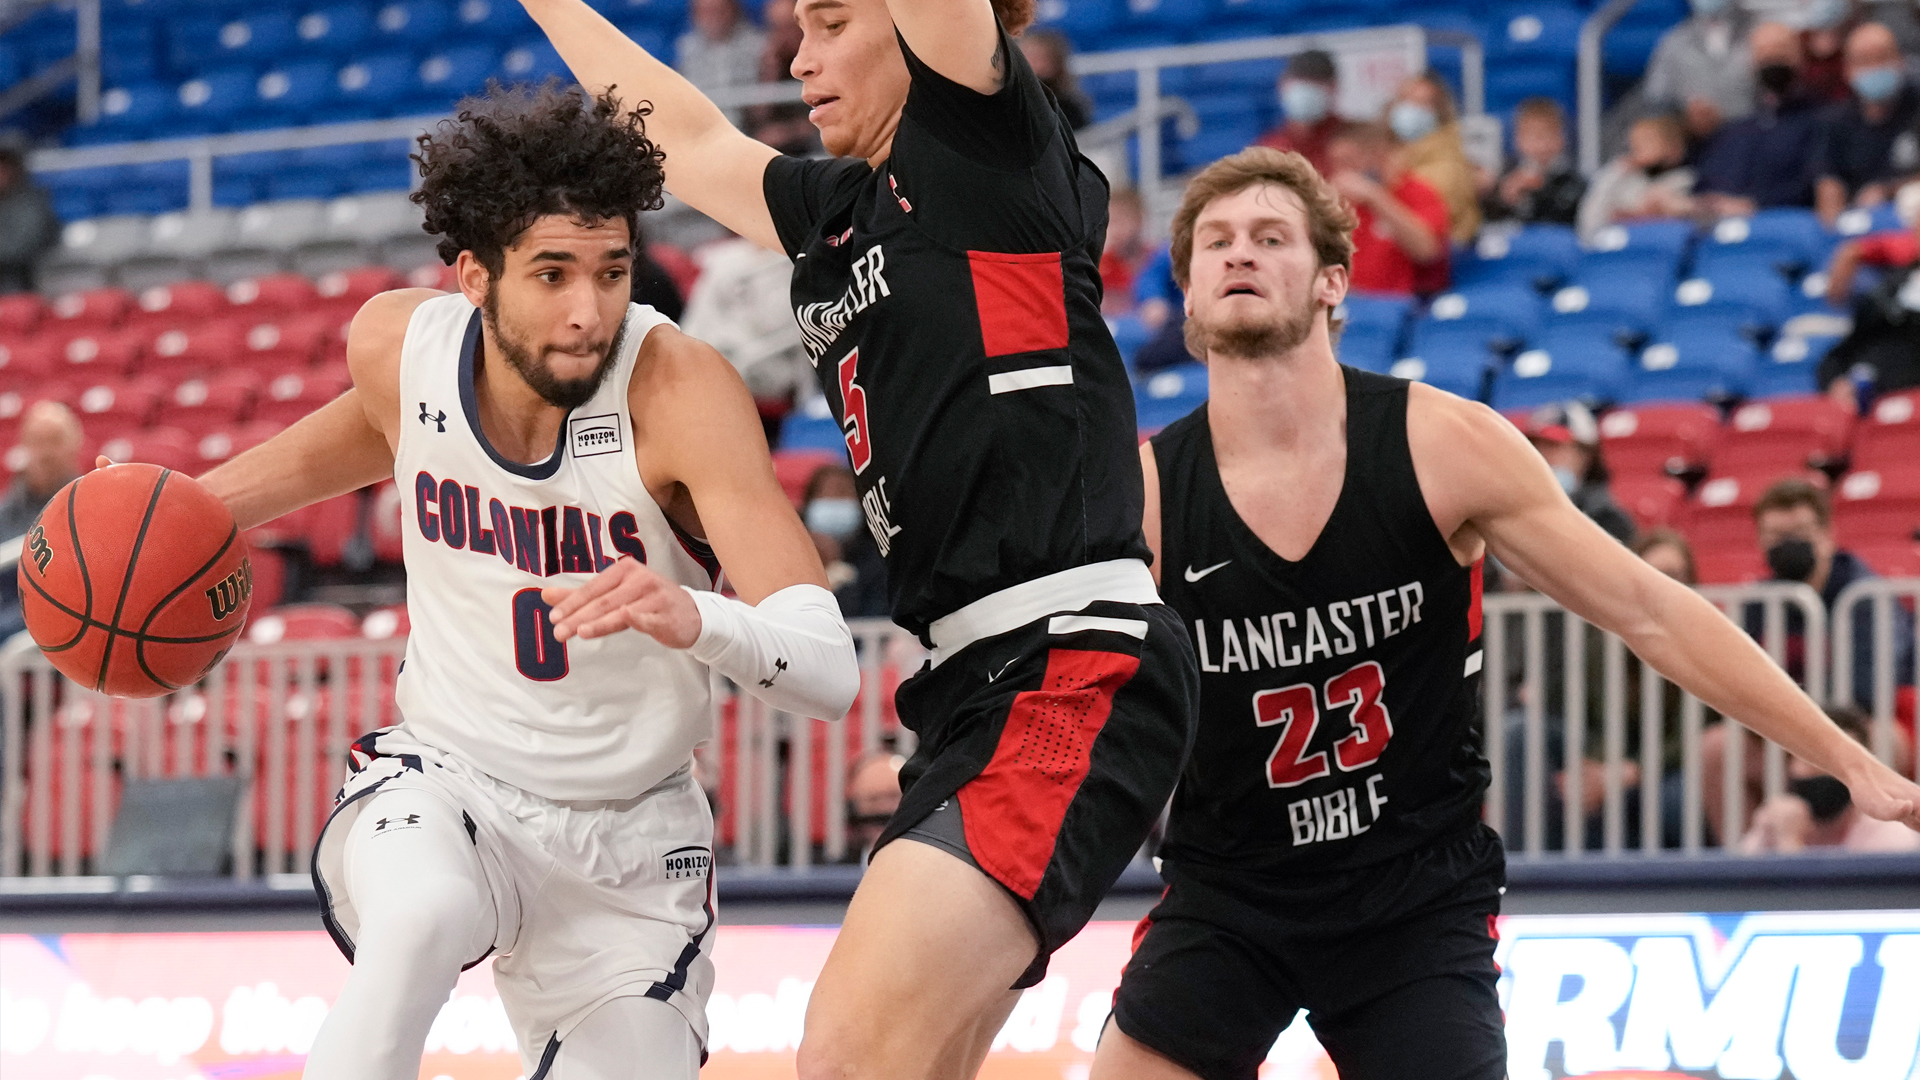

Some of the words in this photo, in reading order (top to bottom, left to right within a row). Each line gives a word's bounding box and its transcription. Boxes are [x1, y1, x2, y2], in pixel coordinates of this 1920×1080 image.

[578, 431, 614, 441] HORIZON
[837, 345, 872, 476] 5
[415, 470, 648, 578] COLONIALS
[205, 556, 253, 621] Wil
[511, 586, 570, 682] 0
[1194, 580, 1425, 674] LANCASTER
[1252, 660, 1394, 789] 23
[666, 856, 709, 870] HORIZO
[666, 870, 706, 879] LEAG
[1503, 932, 1920, 1080] RMU
